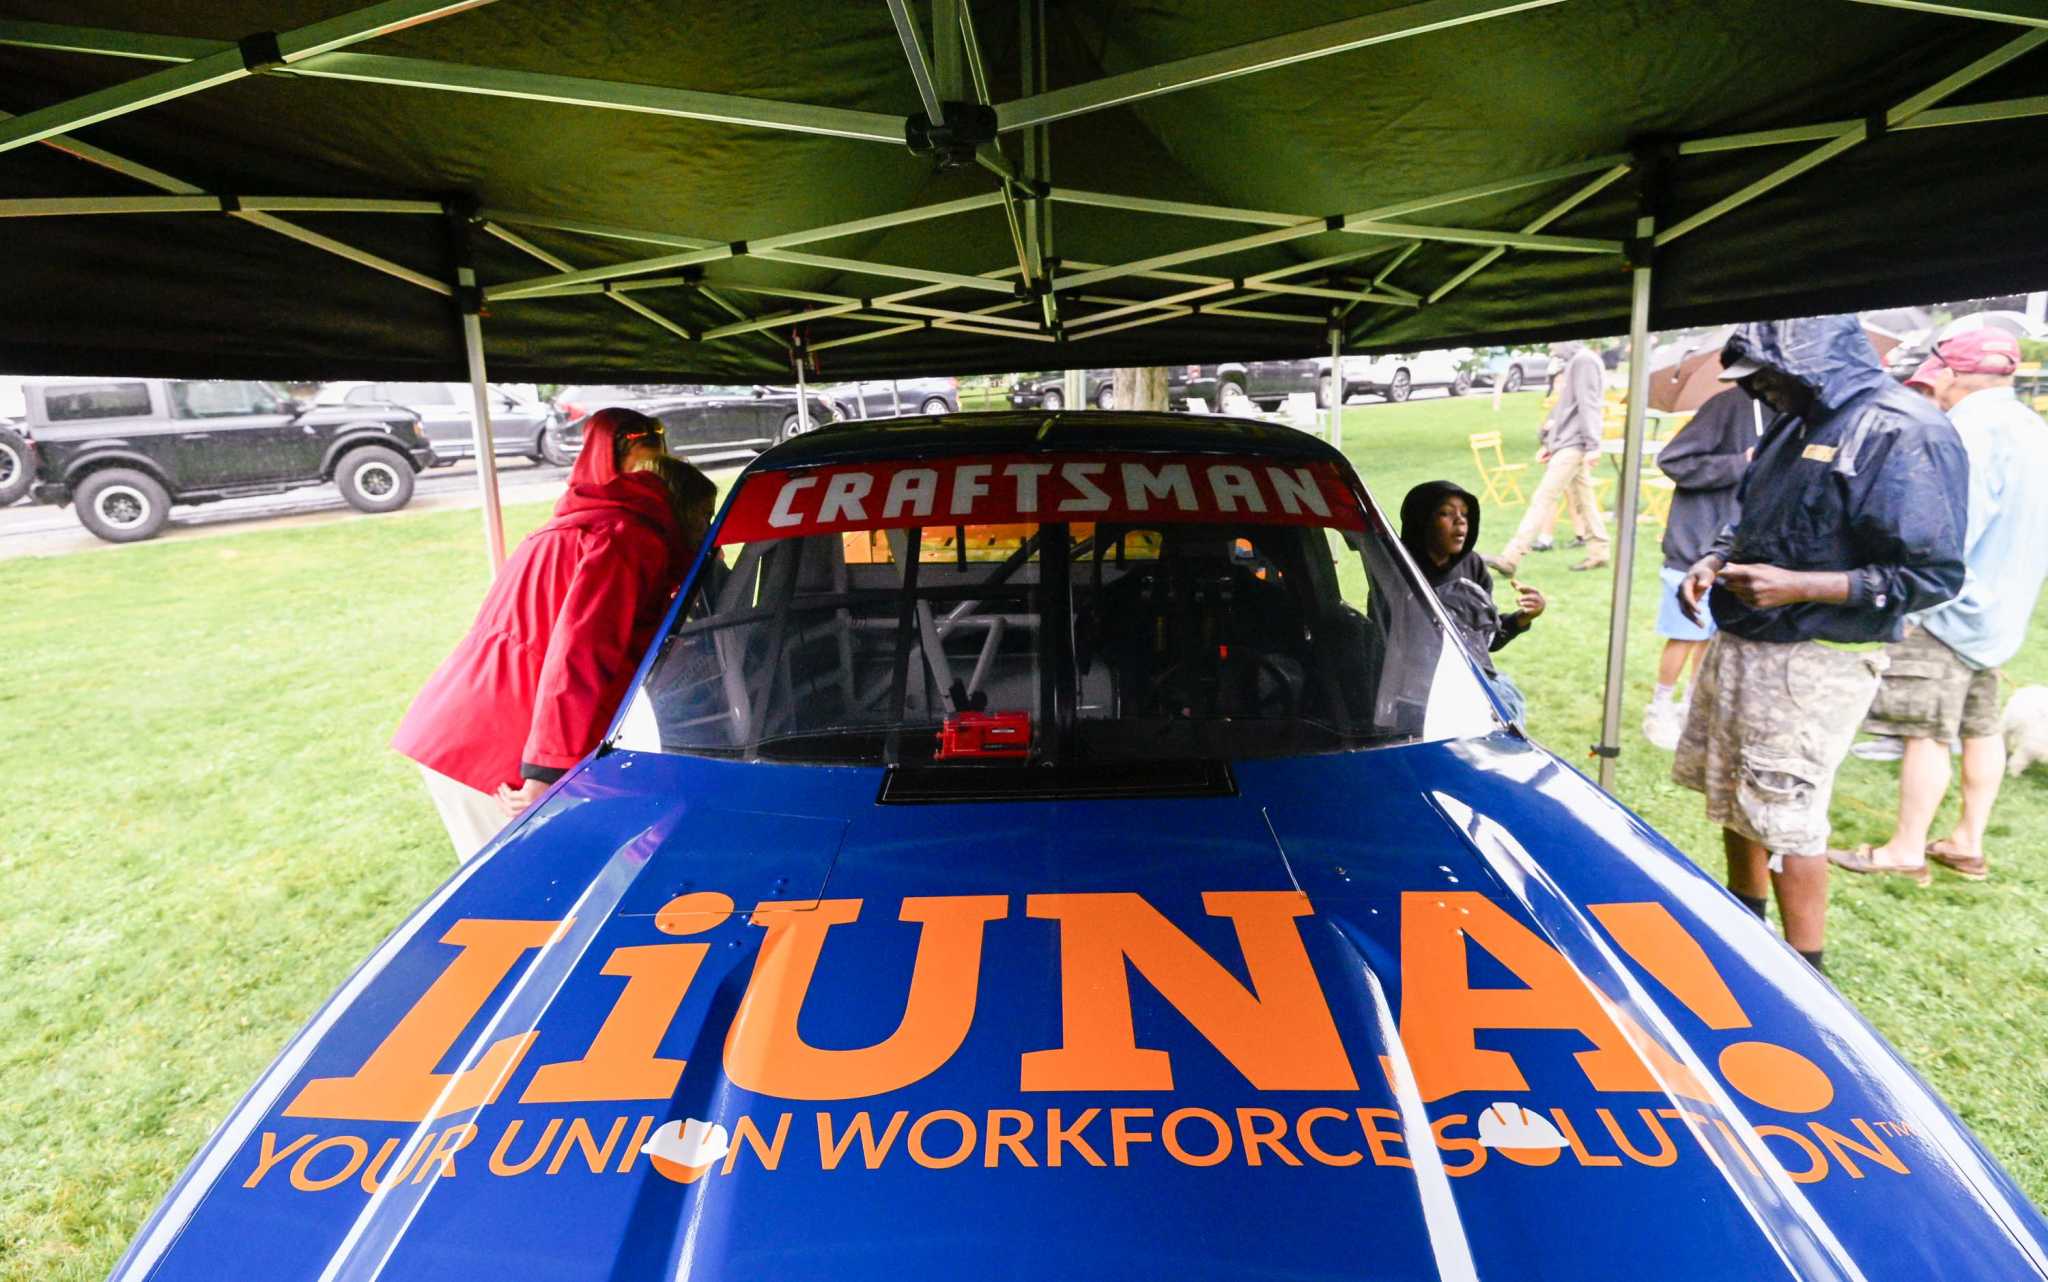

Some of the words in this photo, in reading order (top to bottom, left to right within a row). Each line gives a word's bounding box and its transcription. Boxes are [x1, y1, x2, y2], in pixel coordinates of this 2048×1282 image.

[769, 461, 1333, 528] CRAFTSMAN
[282, 890, 1835, 1122] LiUNA!
[242, 1122, 480, 1195] YOUR
[488, 1113, 793, 1184] UNION
[818, 1107, 1415, 1170] WORKFORCE
